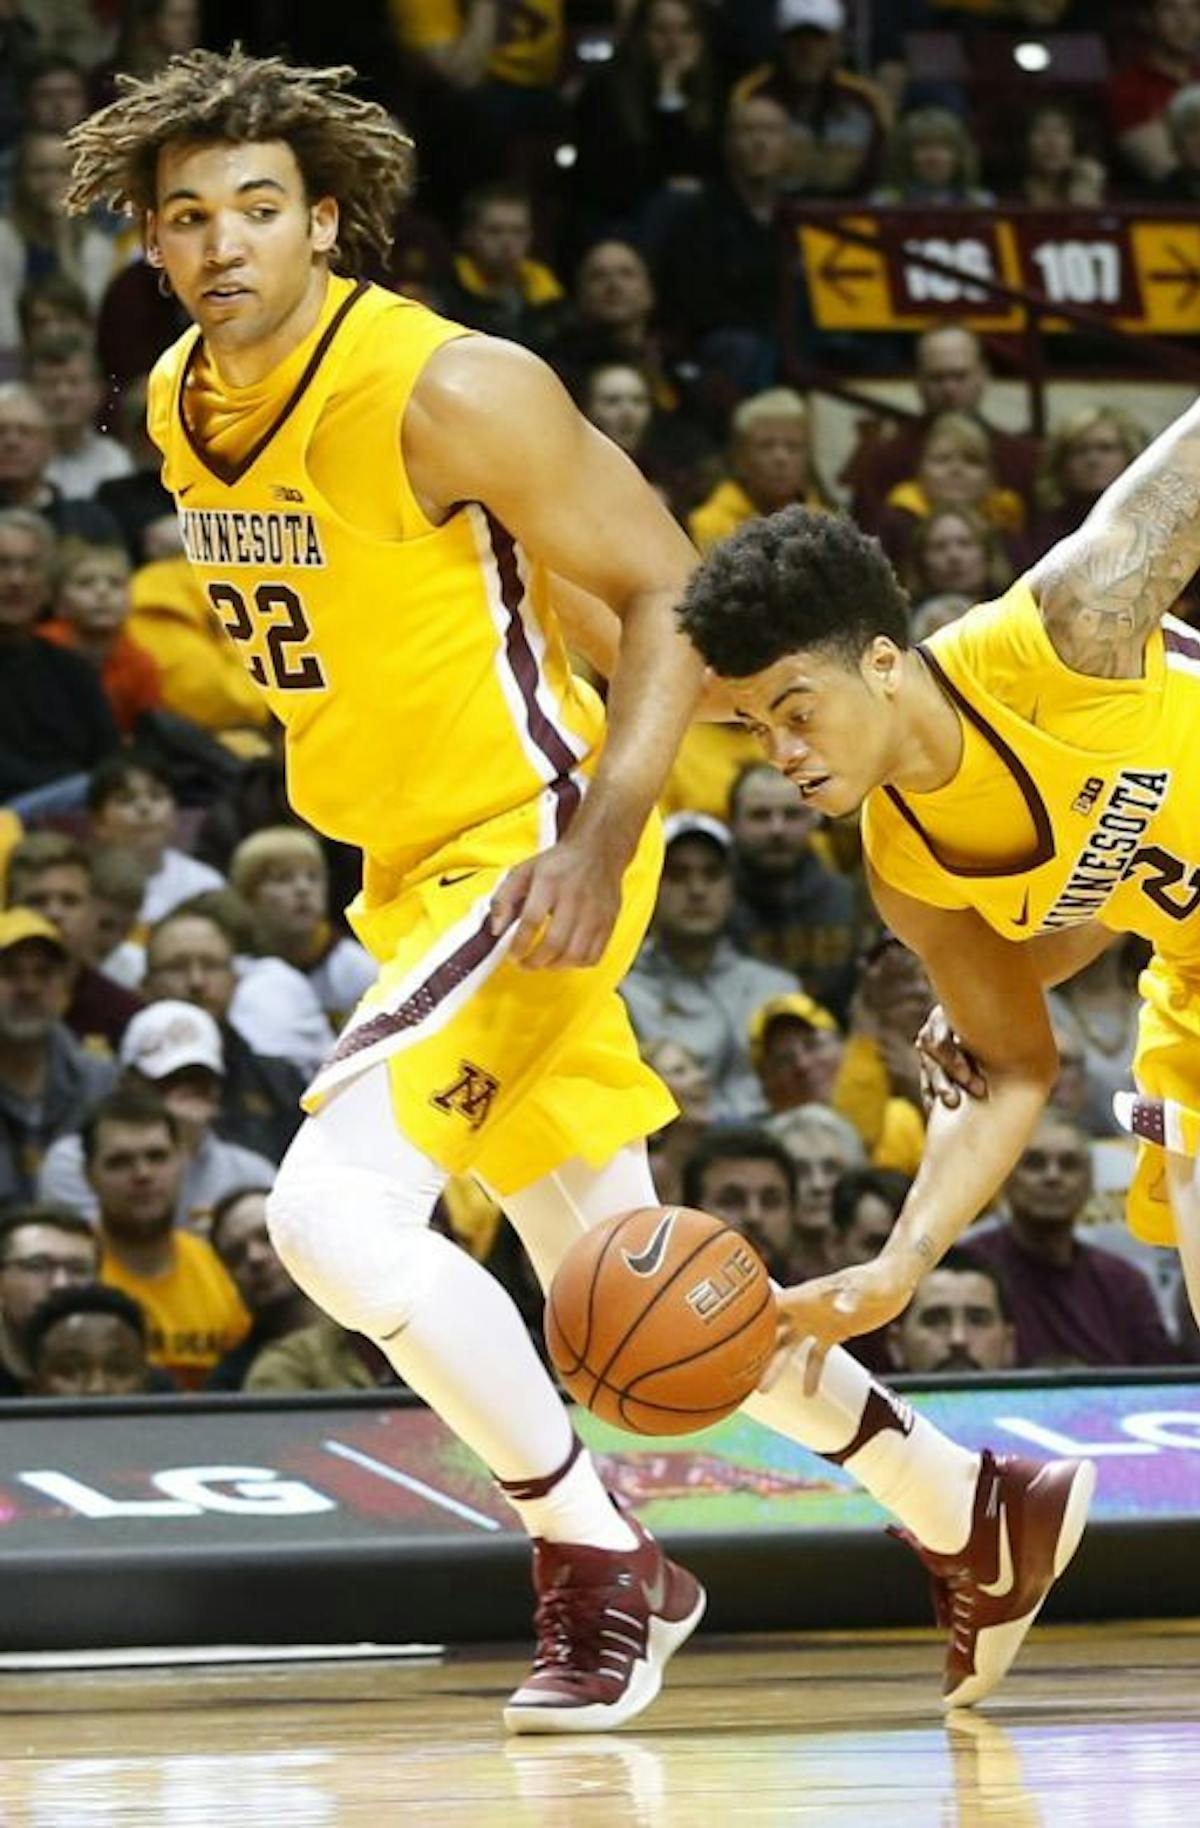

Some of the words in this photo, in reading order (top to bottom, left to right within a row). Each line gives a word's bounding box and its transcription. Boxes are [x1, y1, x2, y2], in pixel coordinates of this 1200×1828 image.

[1033, 240, 1119, 302] 107
[181, 509, 325, 567] INNESOTA
[208, 582, 327, 690] 22
[1036, 769, 1170, 932] INNESOTA
[685, 1246, 759, 1321] ELITE
[17, 1465, 337, 1518] LG
